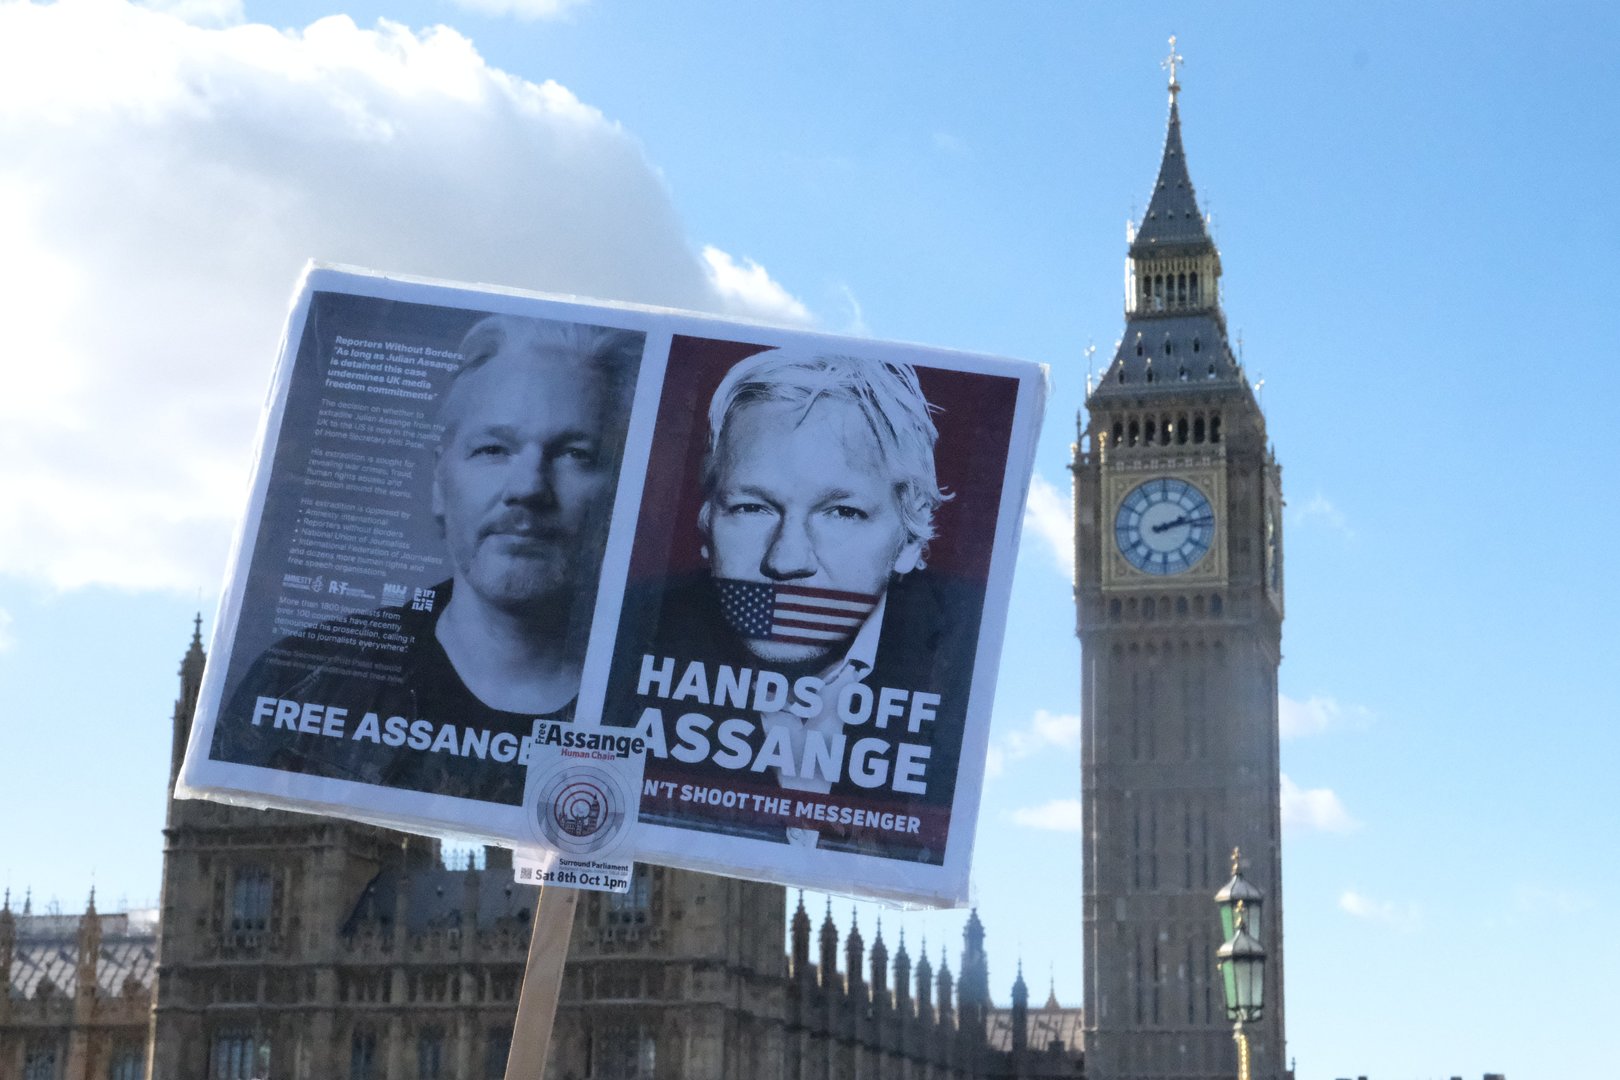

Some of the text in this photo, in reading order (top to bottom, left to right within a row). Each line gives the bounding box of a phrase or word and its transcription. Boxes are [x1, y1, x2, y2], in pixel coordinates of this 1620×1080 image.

[335, 336, 383, 349] Reporters
[385, 342, 424, 355] Without
[341, 359, 383, 371] detained
[384, 364, 403, 374] this
[350, 349, 372, 360] long
[386, 354, 415, 364] Julian
[417, 358, 460, 371] Assange
[325, 379, 366, 391] freedom
[328, 370, 432, 389] undermines UK media
[321, 399, 336, 407] The
[337, 401, 370, 411] decision
[355, 414, 377, 422] Julian
[379, 417, 411, 428] Assange
[413, 422, 432, 430] from
[325, 430, 348, 439] Home
[349, 433, 386, 445] Secretary
[306, 468, 333, 477] human
[334, 472, 356, 480] rights
[306, 509, 338, 520] Amnesty
[315, 501, 356, 511] extradition
[365, 508, 400, 517] opposed
[401, 512, 411, 520] by
[303, 519, 341, 530] Reporters
[302, 529, 333, 538] National
[335, 533, 357, 542] Union
[370, 538, 410, 549] Journalists
[299, 538, 347, 551] International
[348, 545, 389, 556] Federation
[401, 552, 443, 564] Journalists
[306, 550, 334, 559] dozens
[288, 557, 304, 565] free
[283, 574, 312, 584] AMNESTY
[279, 597, 300, 606] More
[301, 600, 319, 609] than
[340, 605, 380, 617] journalists
[382, 611, 401, 620] from
[274, 618, 318, 629] denounced
[332, 627, 381, 639] prosecution,
[382, 634, 408, 643] calling
[312, 614, 348, 623] countries
[349, 617, 368, 626] have
[369, 622, 402, 632] recently
[317, 634, 356, 645] journalists
[636, 654, 941, 733] HANDS OFF
[251, 696, 348, 738] FREE
[535, 723, 644, 758] Free Assange
[560, 748, 616, 761] Human Chain
[634, 707, 932, 795] ASSANGE
[644, 779, 922, 834] N'T SHOOT THE MESSENGER
[560, 858, 628, 871] Surround Parliament
[536, 869, 555, 880] Sat
[558, 871, 576, 883] 8th
[580, 874, 600, 885] Oct
[604, 876, 627, 889] 1pm
